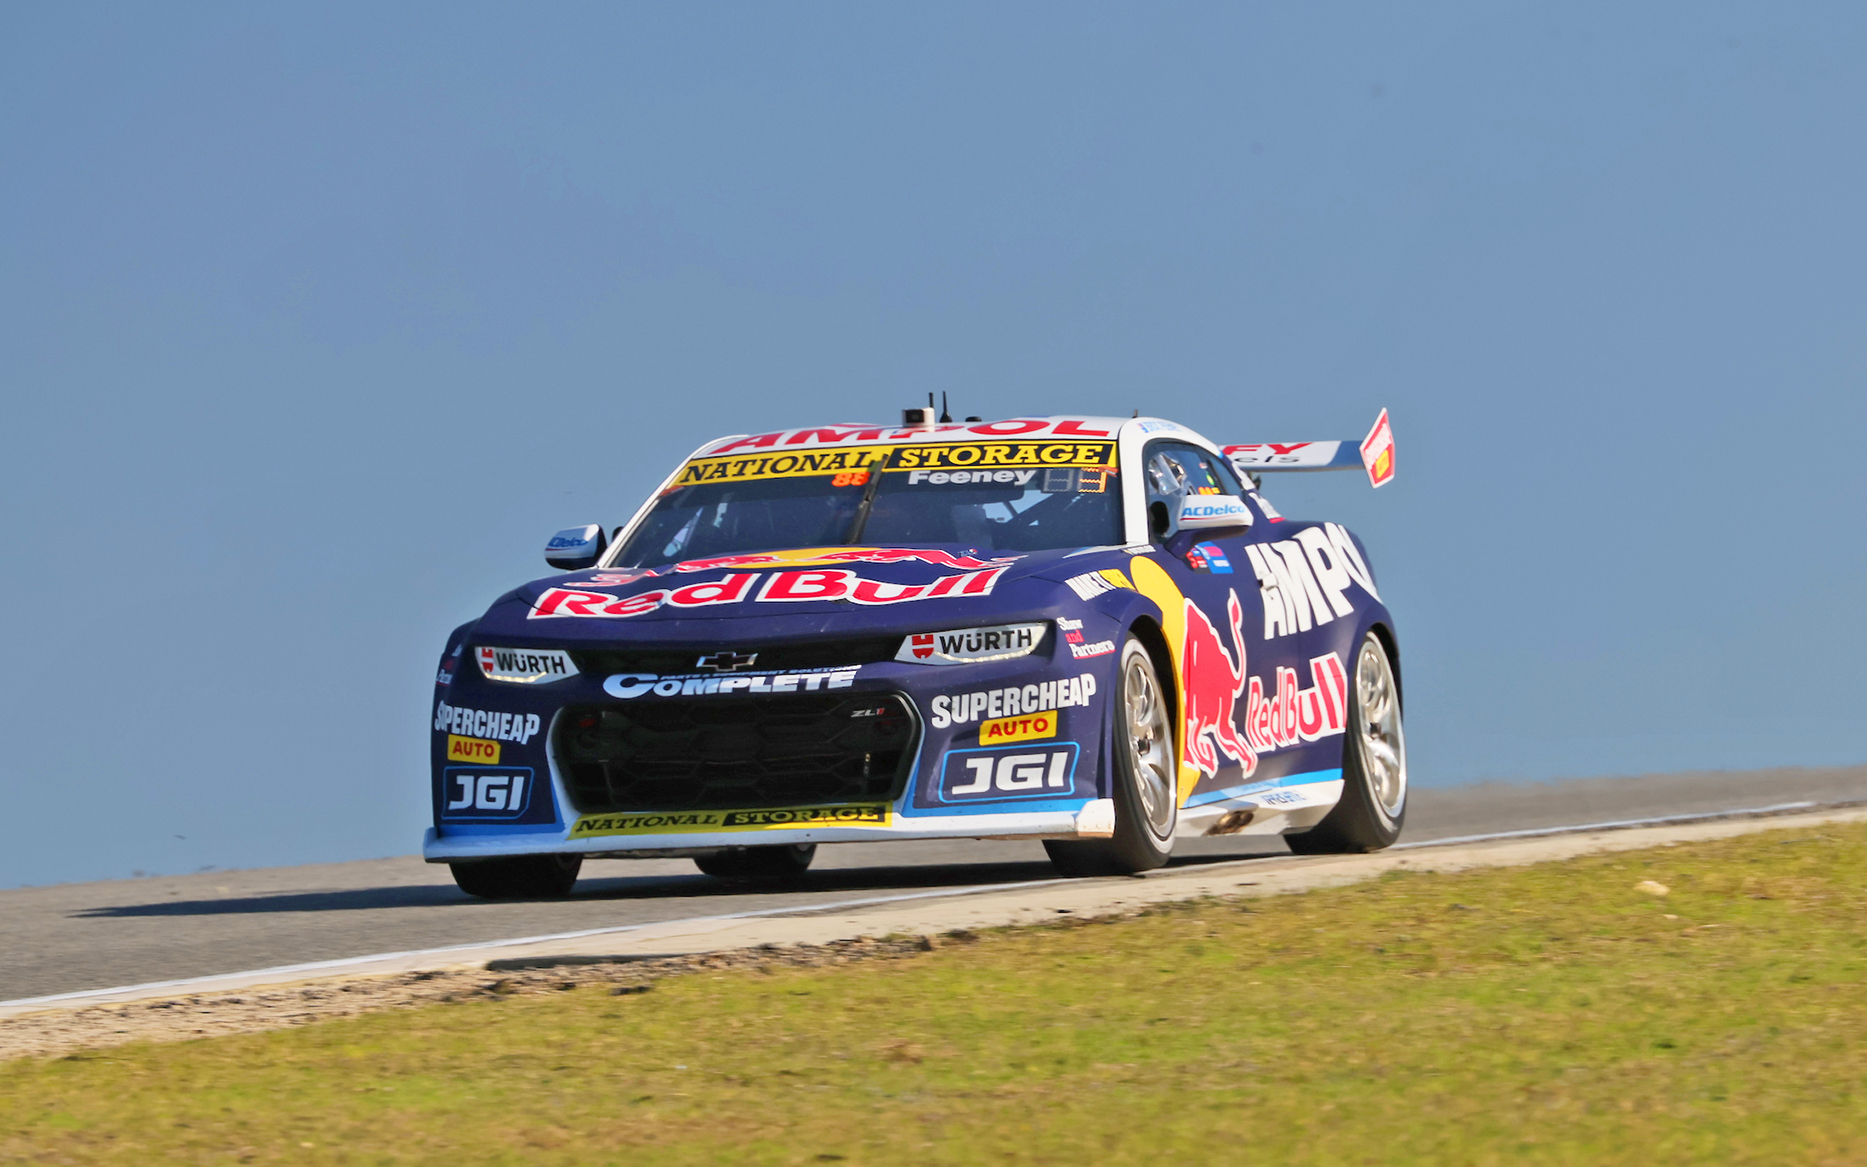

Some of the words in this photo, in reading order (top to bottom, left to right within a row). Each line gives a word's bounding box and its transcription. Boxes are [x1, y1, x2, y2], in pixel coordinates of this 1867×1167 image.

[680, 451, 873, 483] NATIONAL
[899, 444, 1103, 468] STORAGE
[908, 469, 1037, 485] Feeney
[1182, 503, 1245, 517] ACDelco
[526, 572, 762, 619] Red
[755, 567, 1010, 605] Bull
[1056, 616, 1084, 631] Shaw
[939, 628, 1032, 654] WÜRTH
[1065, 629, 1085, 644] and
[1069, 640, 1116, 658] Partners
[496, 653, 567, 675] WÜRTH
[602, 671, 858, 699] COMPLETE
[931, 673, 1097, 729] SUPERCHEAP
[988, 717, 1049, 738] AUTO
[452, 740, 495, 758] AUTO
[951, 752, 1069, 795] JGI
[448, 775, 525, 811] JGI
[576, 814, 719, 833] NATIONAL
[734, 806, 879, 824] STORAGE
